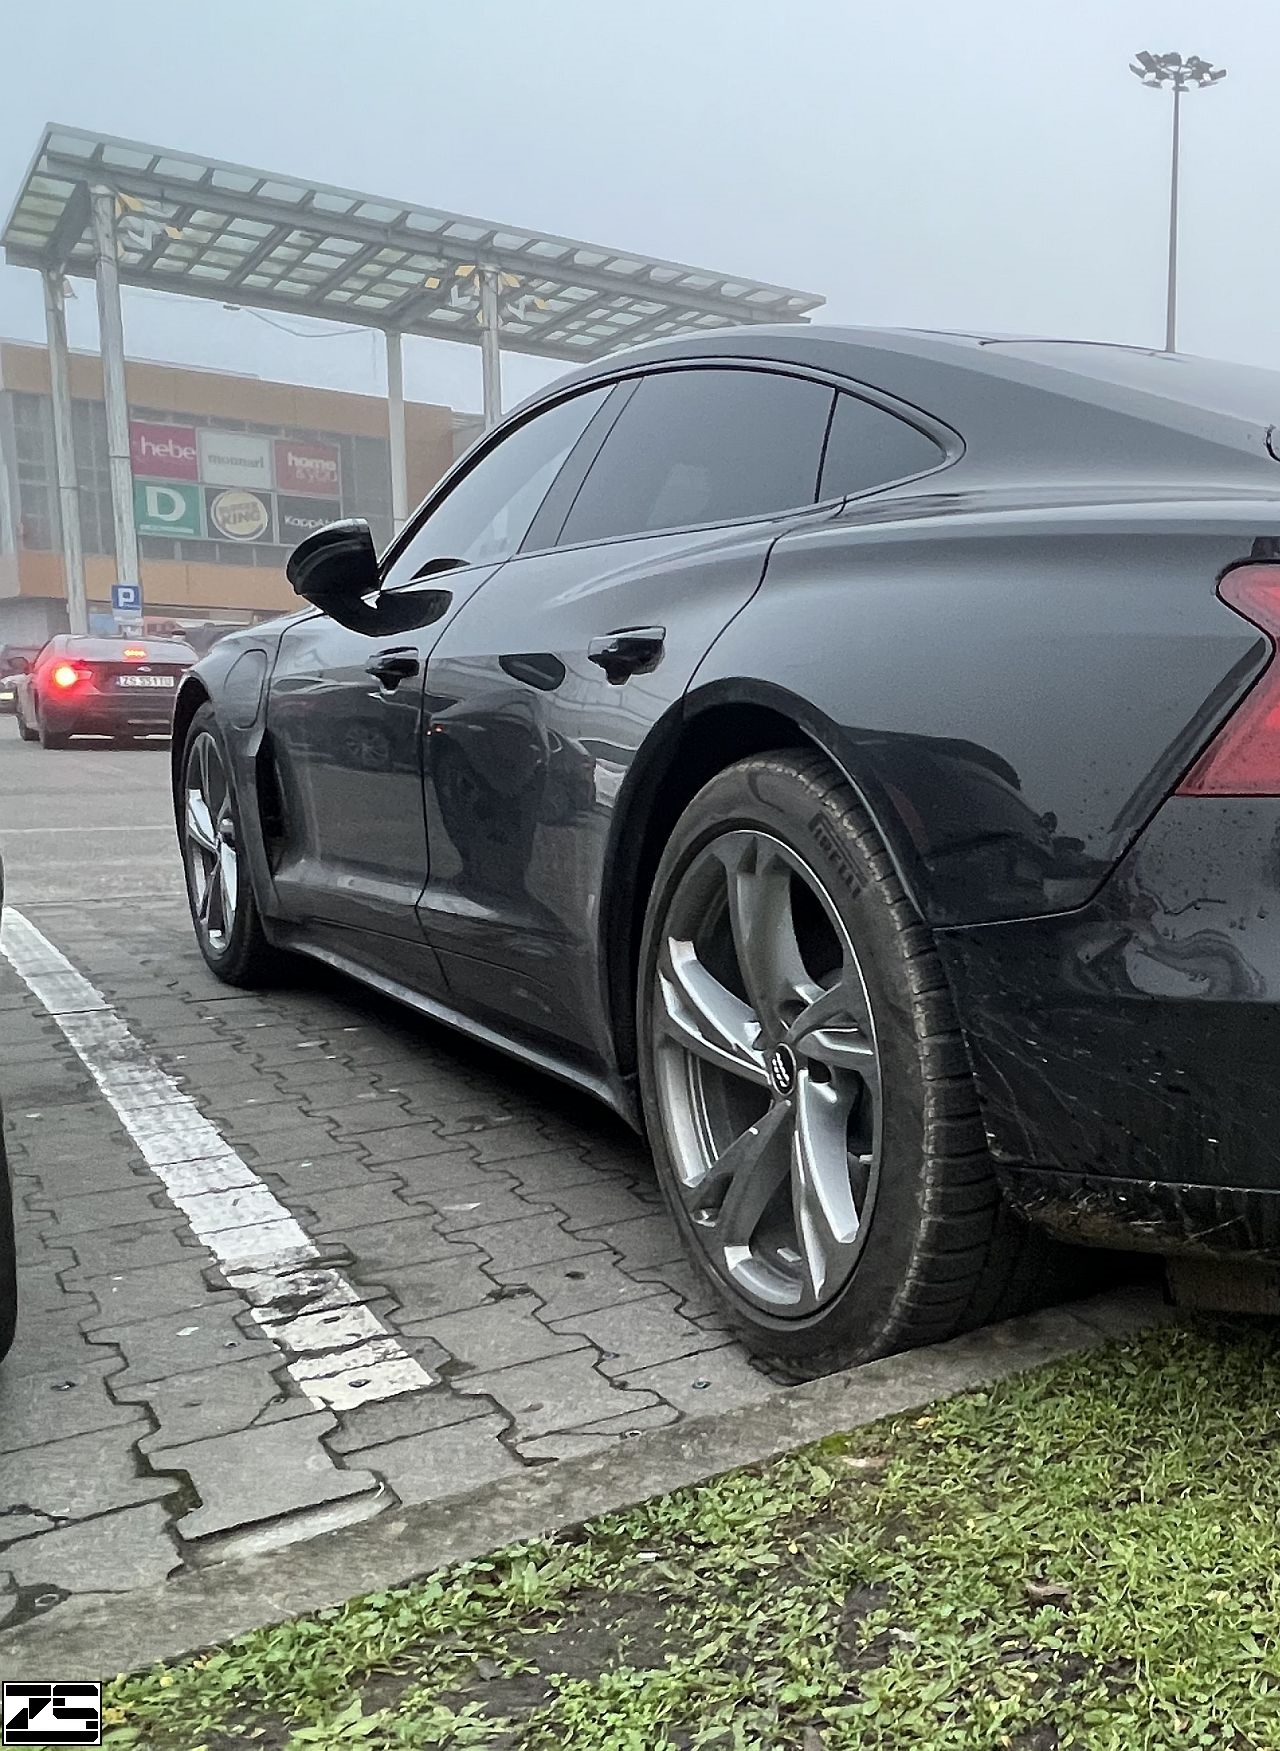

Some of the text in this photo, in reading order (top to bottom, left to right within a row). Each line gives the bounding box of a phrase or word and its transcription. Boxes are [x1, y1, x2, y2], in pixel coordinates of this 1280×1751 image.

[141, 435, 196, 460] hebe
[287, 451, 337, 471] home
[145, 486, 186, 522] D
[117, 588, 135, 608] P
[808, 810, 869, 899] PIRELLI
